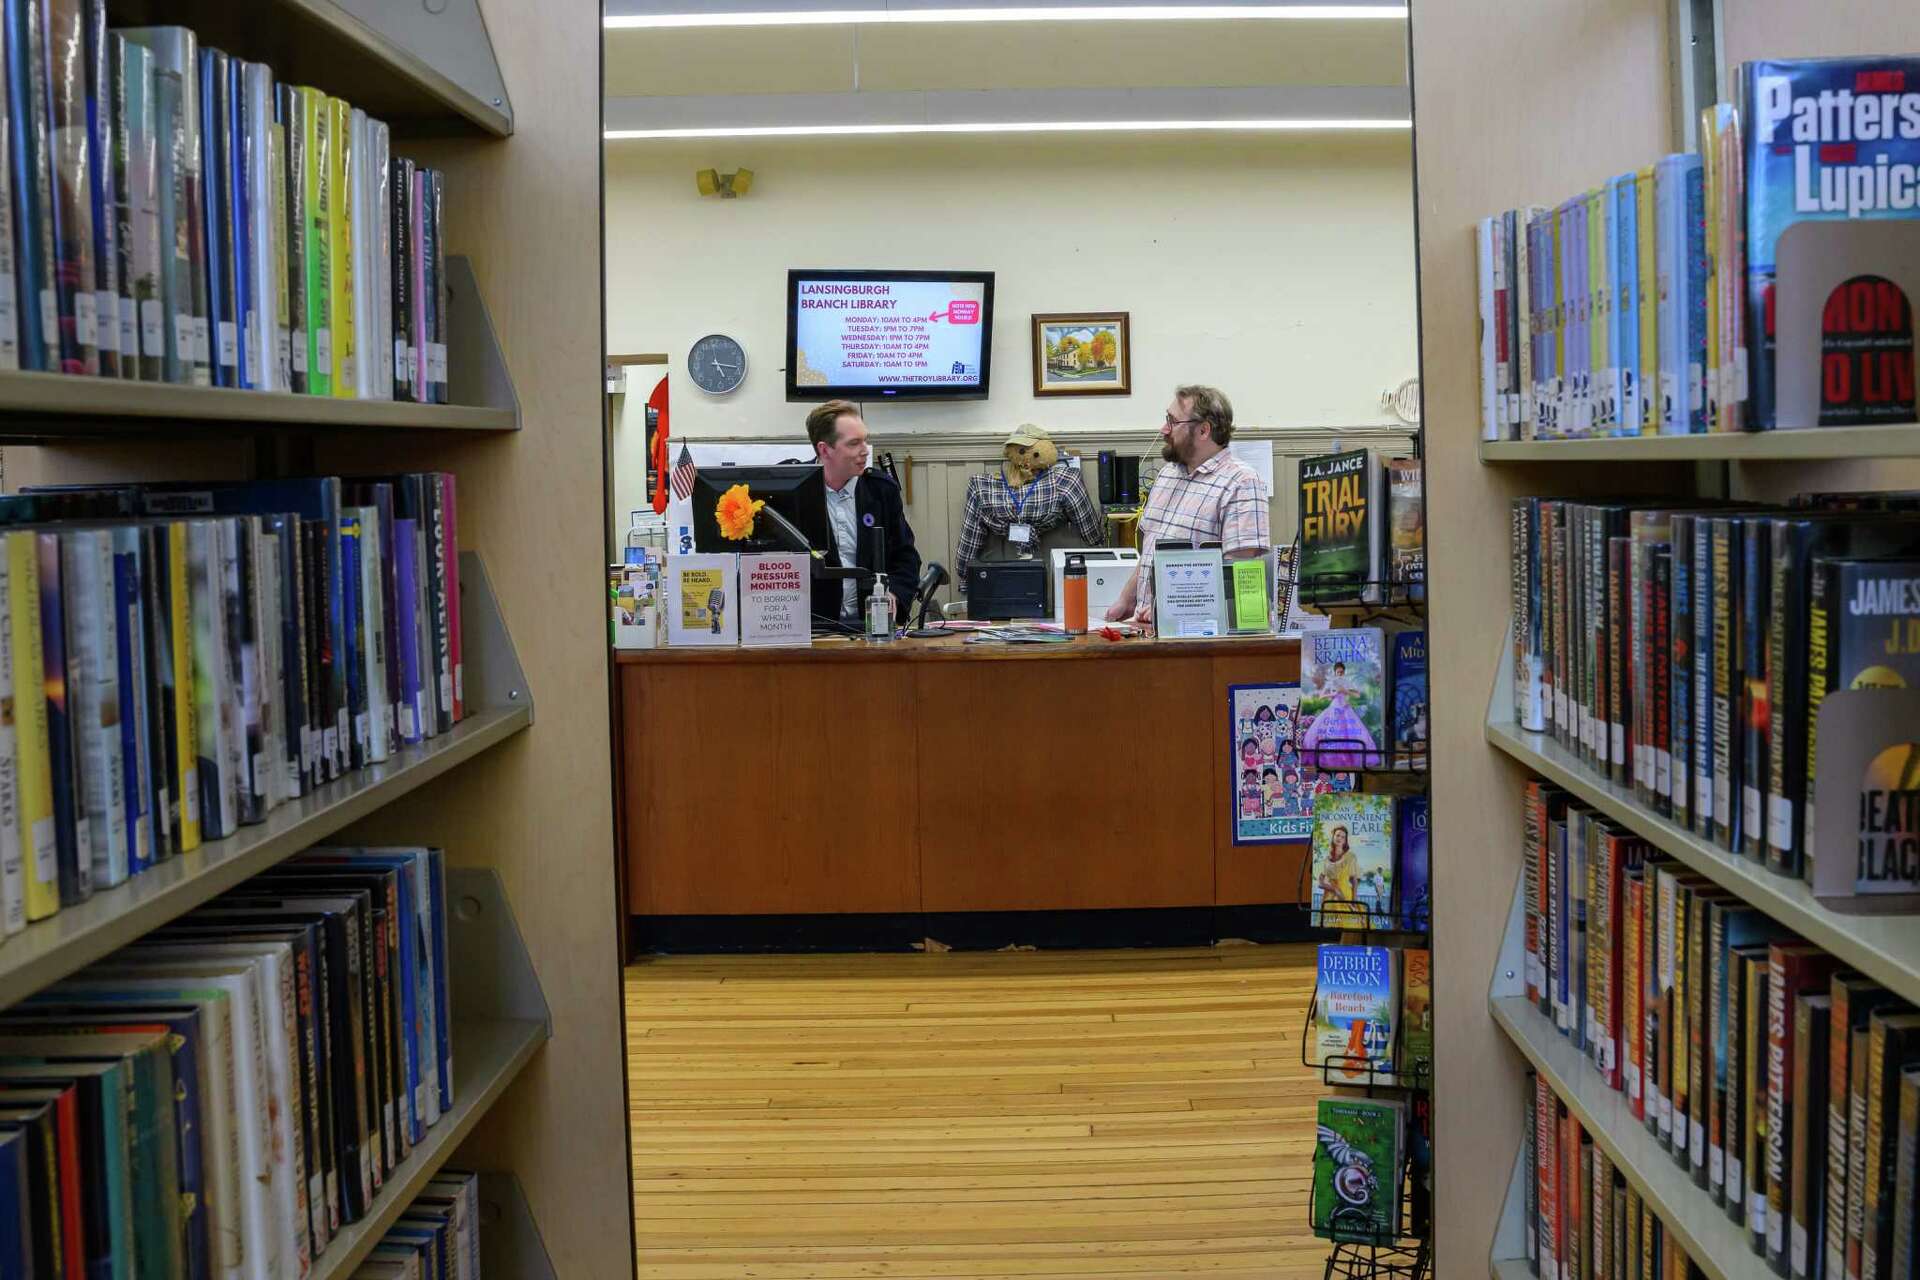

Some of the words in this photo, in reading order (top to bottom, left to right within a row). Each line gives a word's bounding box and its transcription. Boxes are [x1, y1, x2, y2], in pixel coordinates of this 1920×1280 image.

[396, 170, 405, 204] SISTER,
[397, 255, 405, 304] MONSTER
[801, 285, 890, 295] LANSINGBURGH
[801, 299, 848, 309] BRANCH
[851, 299, 898, 309] LIBRARY
[878, 375, 978, 383] WWW.THETROYLIBRARY.ORG
[1303, 466, 1325, 478] J.A.
[1327, 456, 1363, 474] JANCE
[1302, 474, 1366, 514] TRIAL
[1304, 508, 1365, 544] FURY
[1512, 509, 1520, 553] JAMES
[1520, 507, 1528, 550] JAMES
[1541, 510, 1549, 559] JAMES
[1551, 511, 1559, 560] JAMES
[758, 562, 792, 571] BLOOD
[1696, 532, 1706, 570] JAMES
[1713, 535, 1729, 593] JAMES
[750, 581, 801, 591] MONITORS
[751, 571, 800, 580] PRESSURE
[1520, 554, 1529, 635] PATTERSON
[1592, 519, 1604, 630] BLOWBACK
[1610, 570, 1619, 618] JAMES
[1772, 558, 1785, 607] JAMES
[752, 595, 762, 603] TO
[763, 594, 800, 603] BORROW
[761, 613, 791, 621] WHOLE
[763, 604, 779, 612] FOR
[1512, 558, 1521, 644] PATTERSON
[1541, 563, 1550, 652] PATTERSON
[1696, 572, 1706, 637] PATTERSON
[1849, 578, 1920, 616] JAMES
[760, 623, 792, 631] MONTH!
[1314, 635, 1367, 650] BETINA
[1713, 596, 1729, 695] PATTERSON
[1810, 607, 1828, 668] JAMES
[1314, 649, 1367, 664] KRAHN
[1610, 623, 1620, 714] PATTERSON
[1696, 652, 1706, 672] THE
[1772, 611, 1784, 704] PATTERSON
[1771, 712, 1782, 772] DEADLY
[0, 756, 15, 828] SPARKS
[1269, 820, 1296, 834] Kids
[1319, 813, 1389, 822] INCONVENIENT
[1351, 821, 1382, 836] EARL
[1525, 793, 1538, 838] JAMES
[1526, 839, 1539, 916] PATTERSON
[1549, 850, 1557, 896] JAMES
[1549, 897, 1557, 971] PATTERSON
[1323, 955, 1382, 971] DEBBIE
[1323, 970, 1380, 986] MASON
[1330, 991, 1374, 1002] Barefoot
[1335, 1003, 1366, 1013] Beach
[1769, 959, 1785, 1038] JAMES
[1727, 1045, 1737, 1146] PATTERSON
[1768, 1041, 1784, 1182] PATTERSON
[1829, 1104, 1846, 1176] JAMES
[1851, 1091, 1867, 1149] JAMES
[1849, 1149, 1864, 1239] PATTERSON
